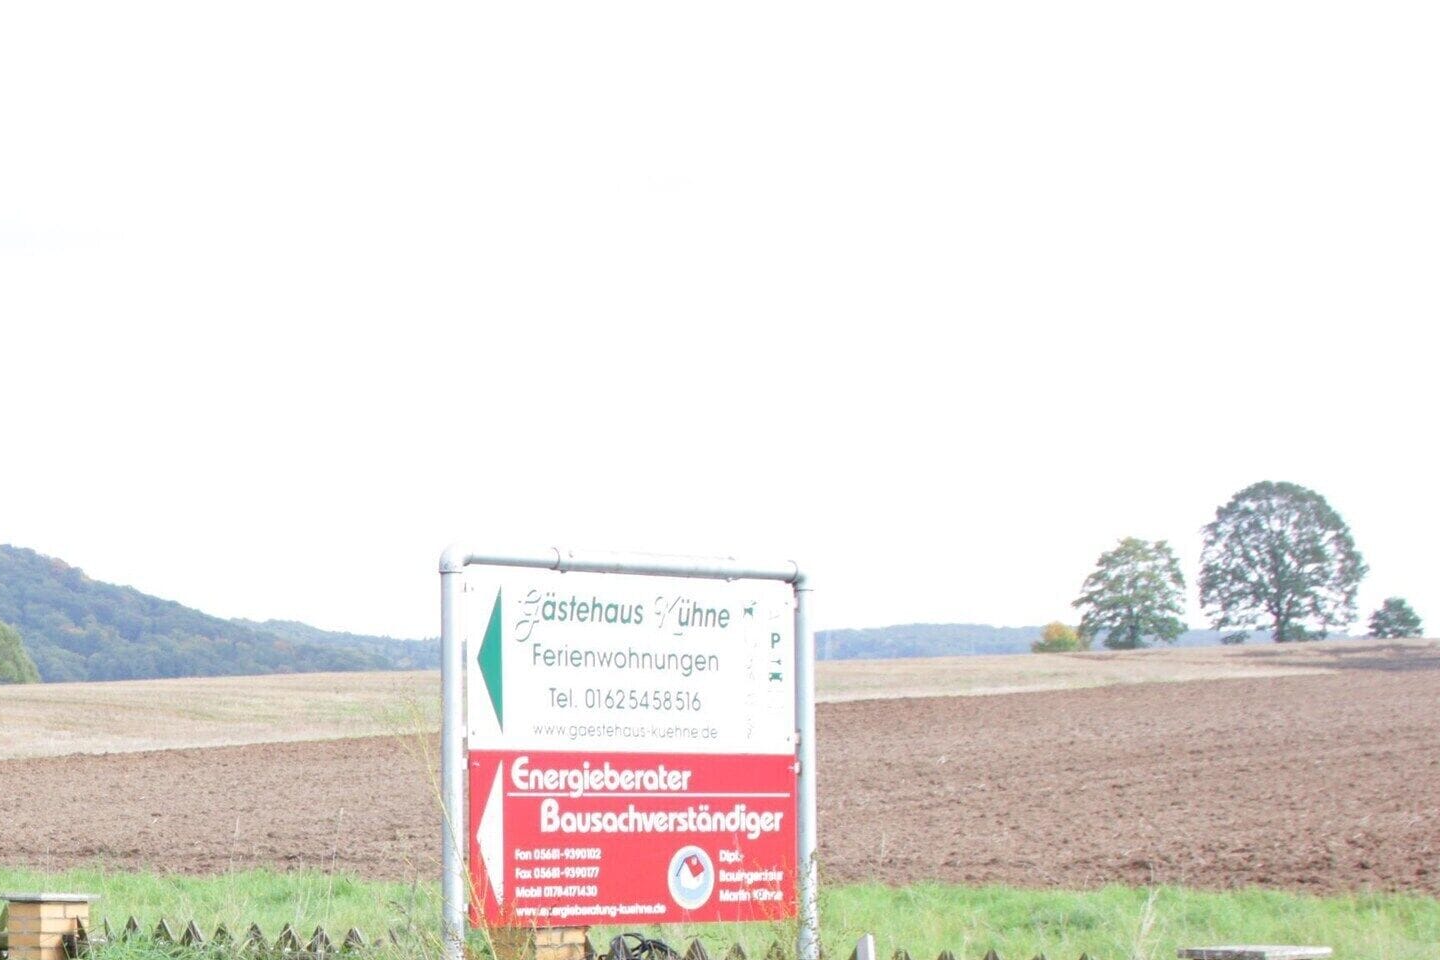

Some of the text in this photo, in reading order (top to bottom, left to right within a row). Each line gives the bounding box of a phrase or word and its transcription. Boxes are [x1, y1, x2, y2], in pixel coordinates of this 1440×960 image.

[515, 589, 643, 642] Gästehaus
[533, 643, 719, 676] Ferienwohnungen
[549, 687, 702, 711] Tel. 01625458516
[533, 724, 718, 741] www.gaestehaus-kuehne.de
[511, 756, 692, 798] Energieberater
[540, 798, 784, 839] Bausachverständiger
[515, 848, 532, 860] Fon
[515, 868, 533, 879] Fax
[515, 886, 542, 898] Mobil
